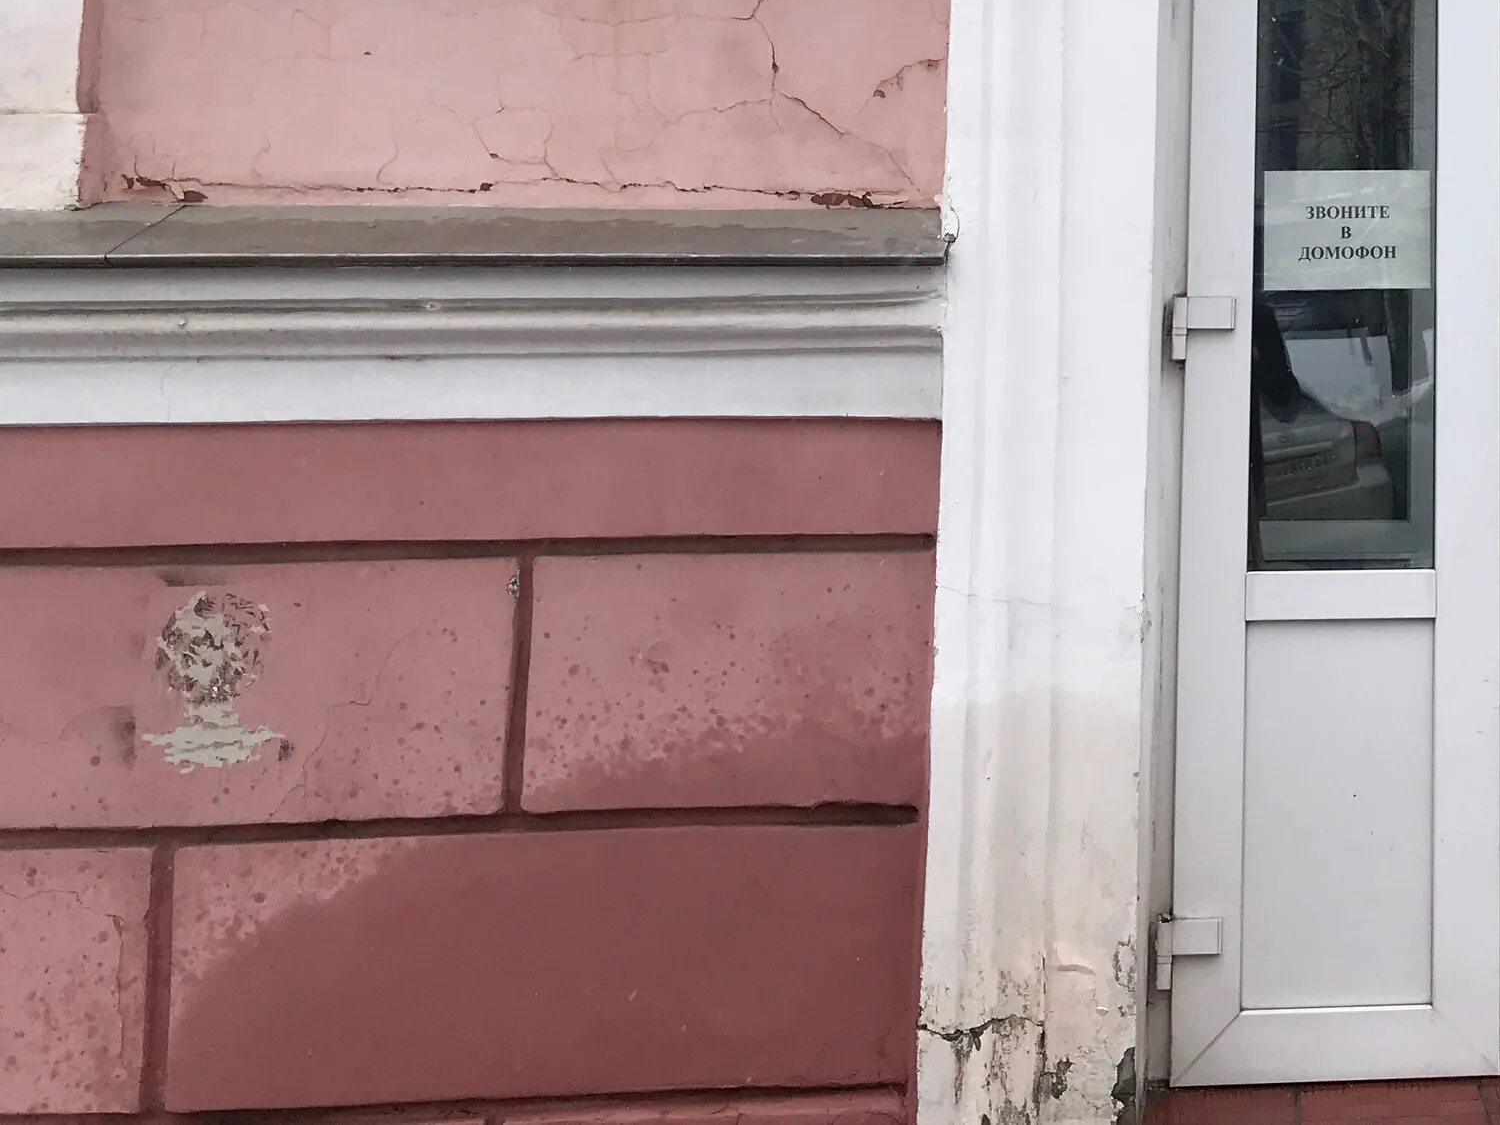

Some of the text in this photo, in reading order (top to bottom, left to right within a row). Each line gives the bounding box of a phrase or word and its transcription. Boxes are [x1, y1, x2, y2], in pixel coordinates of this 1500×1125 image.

[1305, 205, 1390, 220] ЗВОНИТЕ
[1340, 226, 1352, 239] В
[1298, 245, 1397, 262] ДОМОФОН
